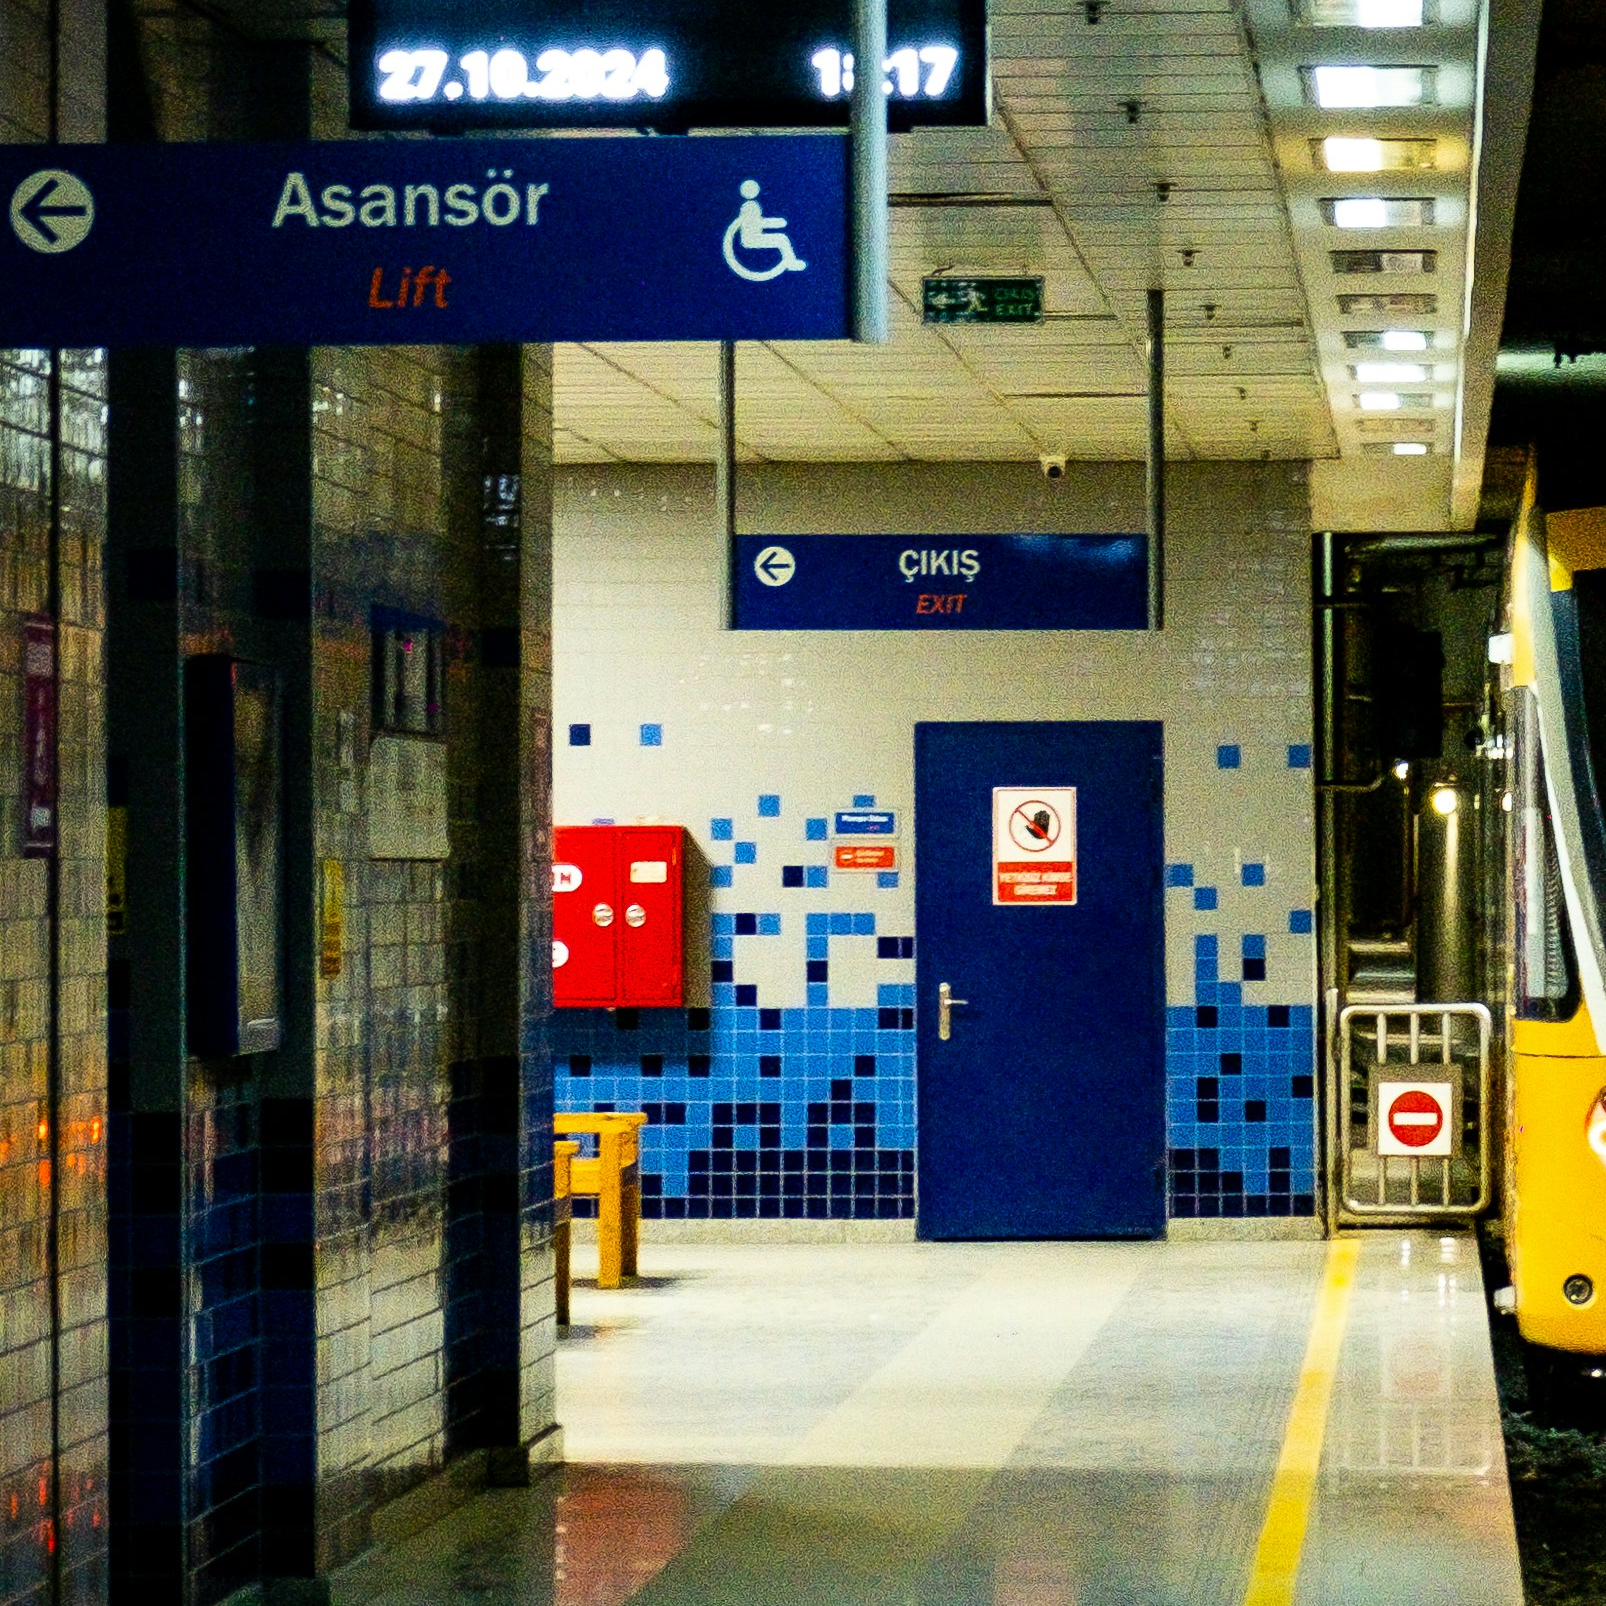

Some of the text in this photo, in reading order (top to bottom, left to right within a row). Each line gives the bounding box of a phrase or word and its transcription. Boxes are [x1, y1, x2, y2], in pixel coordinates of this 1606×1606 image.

[379, 49, 669, 99] 27.10.2024
[811, 46, 958, 96] 1:17
[272, 169, 549, 228] Asansör
[369, 267, 452, 310] Lift
[899, 549, 981, 583] ÇIKIŞ
[916, 594, 968, 615] EXIT
